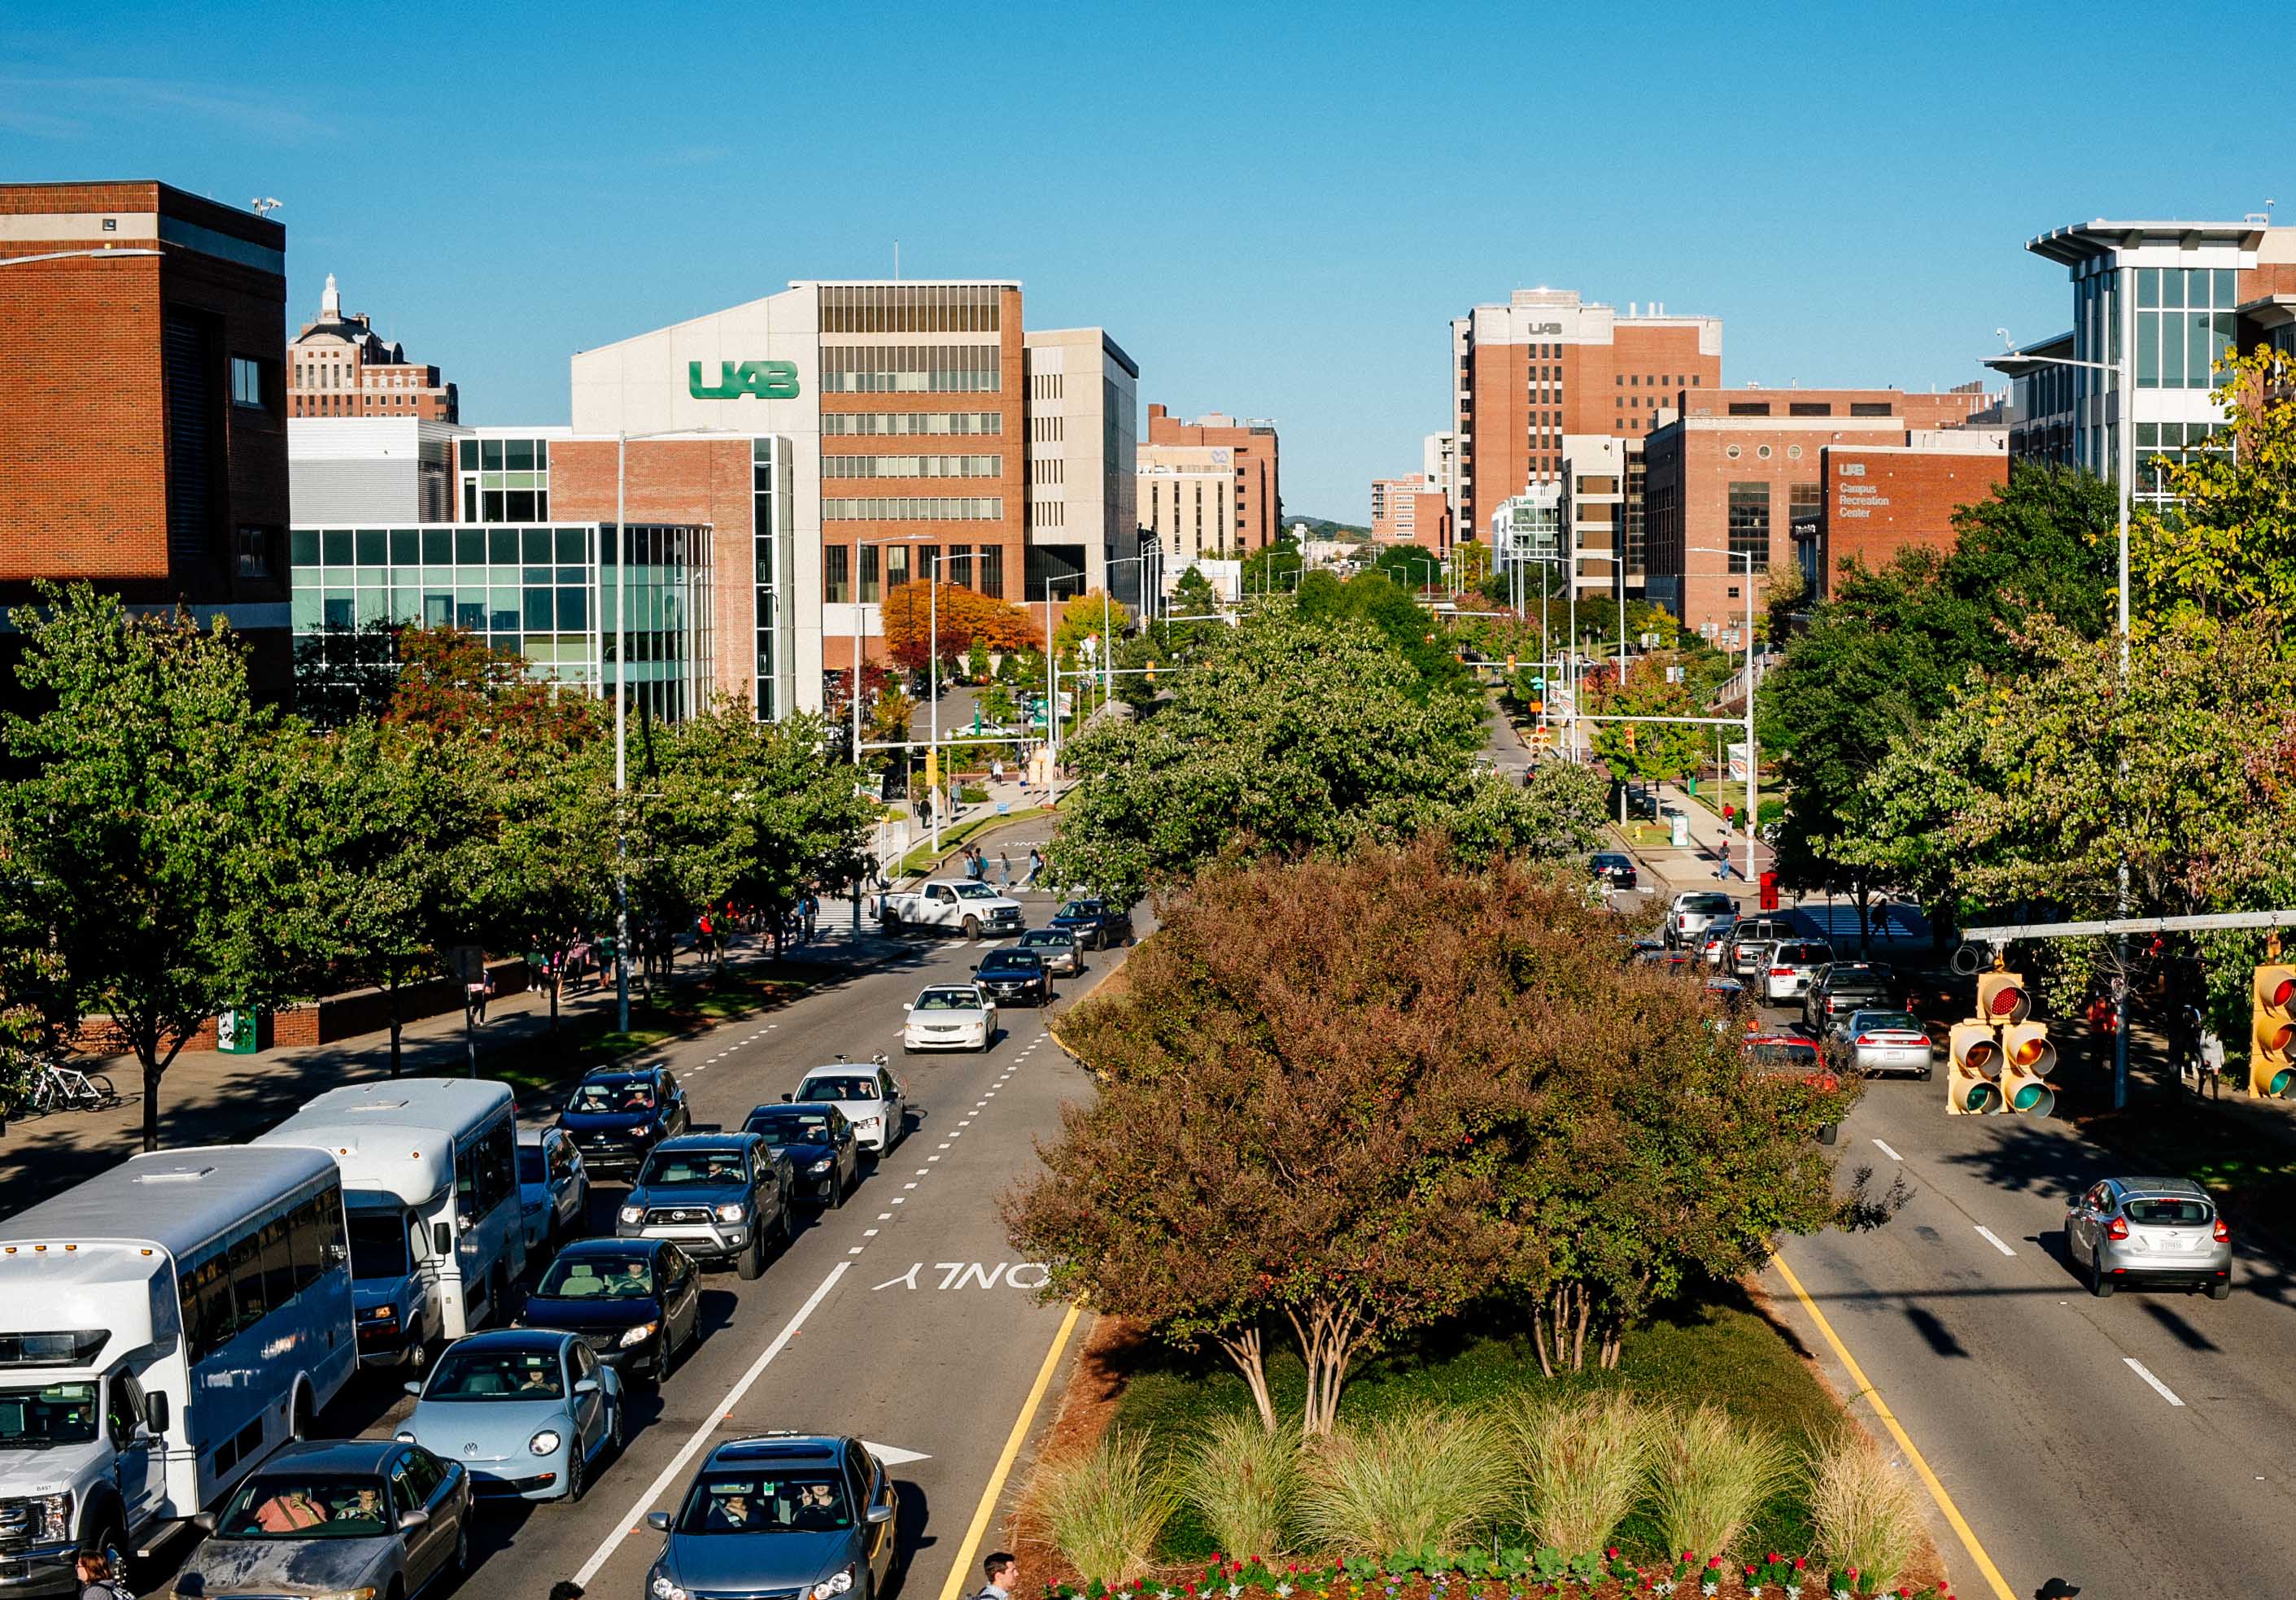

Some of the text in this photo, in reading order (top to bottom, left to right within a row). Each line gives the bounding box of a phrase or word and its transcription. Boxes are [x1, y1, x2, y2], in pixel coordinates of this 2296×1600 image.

[1529, 323, 1562, 334] UAB
[689, 361, 801, 399] UAB
[1840, 464, 1866, 477] UAB
[1840, 482, 1877, 495] Campus
[1840, 495, 1890, 505] Recreation
[1840, 507, 1870, 517] Center
[871, 1262, 1052, 1290] ONLY
